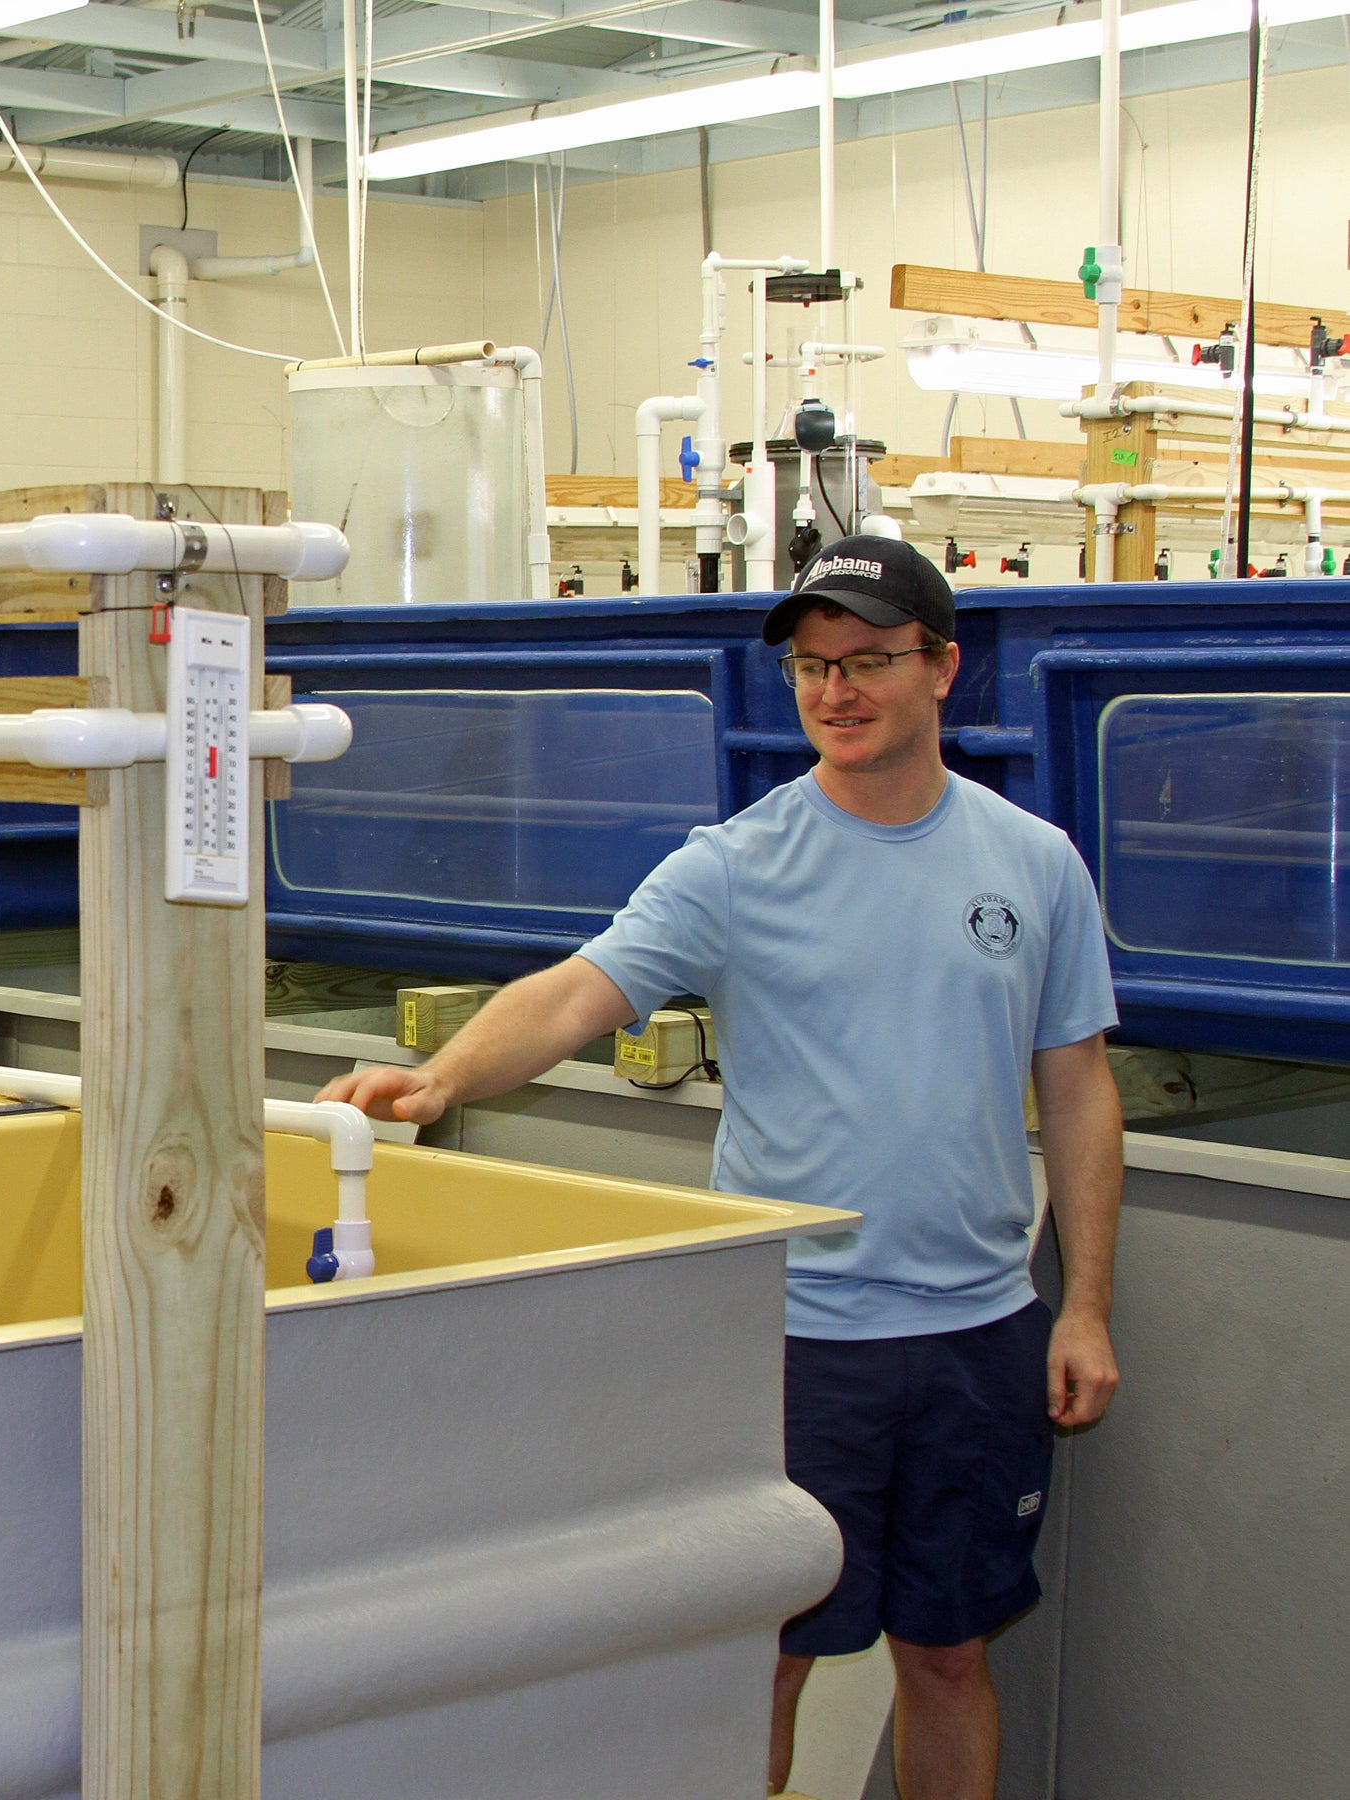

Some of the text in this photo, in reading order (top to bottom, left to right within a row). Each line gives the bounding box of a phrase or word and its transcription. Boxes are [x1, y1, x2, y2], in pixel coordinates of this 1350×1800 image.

[800, 555, 883, 588] Alabama
[828, 569, 883, 580] RESOURCES
[971, 895, 1012, 909] ALABAMA
